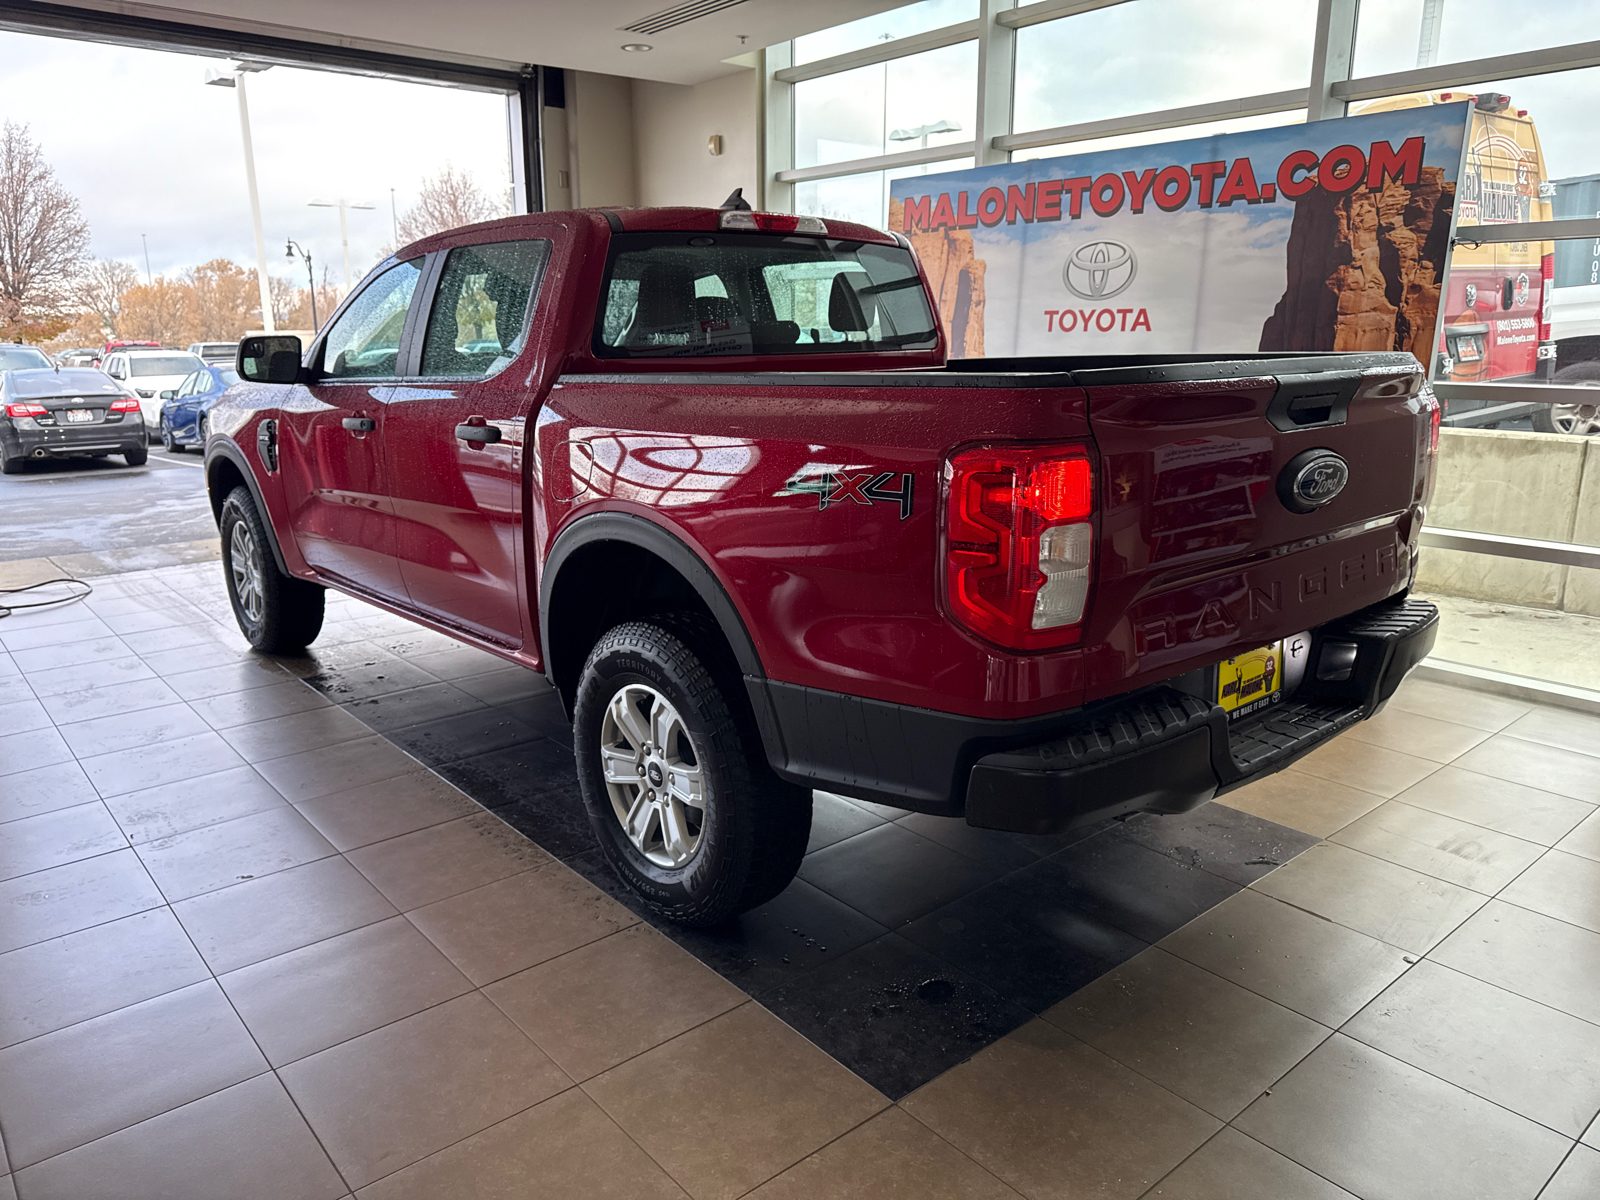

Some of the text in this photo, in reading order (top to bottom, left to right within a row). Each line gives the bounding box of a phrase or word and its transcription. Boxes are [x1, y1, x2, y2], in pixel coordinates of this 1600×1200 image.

[904, 136, 1425, 234] MALONETOYOTA.COM
[1482, 191, 1518, 220] MALONE
[1044, 308, 1152, 332] TOYOTA
[1496, 317, 1535, 333] (801) 553-5800
[1310, 468, 1340, 495] Ford
[1133, 540, 1400, 657] RANGER
[616, 659, 662, 682] TERRITORY
[1233, 697, 1270, 719] WE MAKE IT EASY
